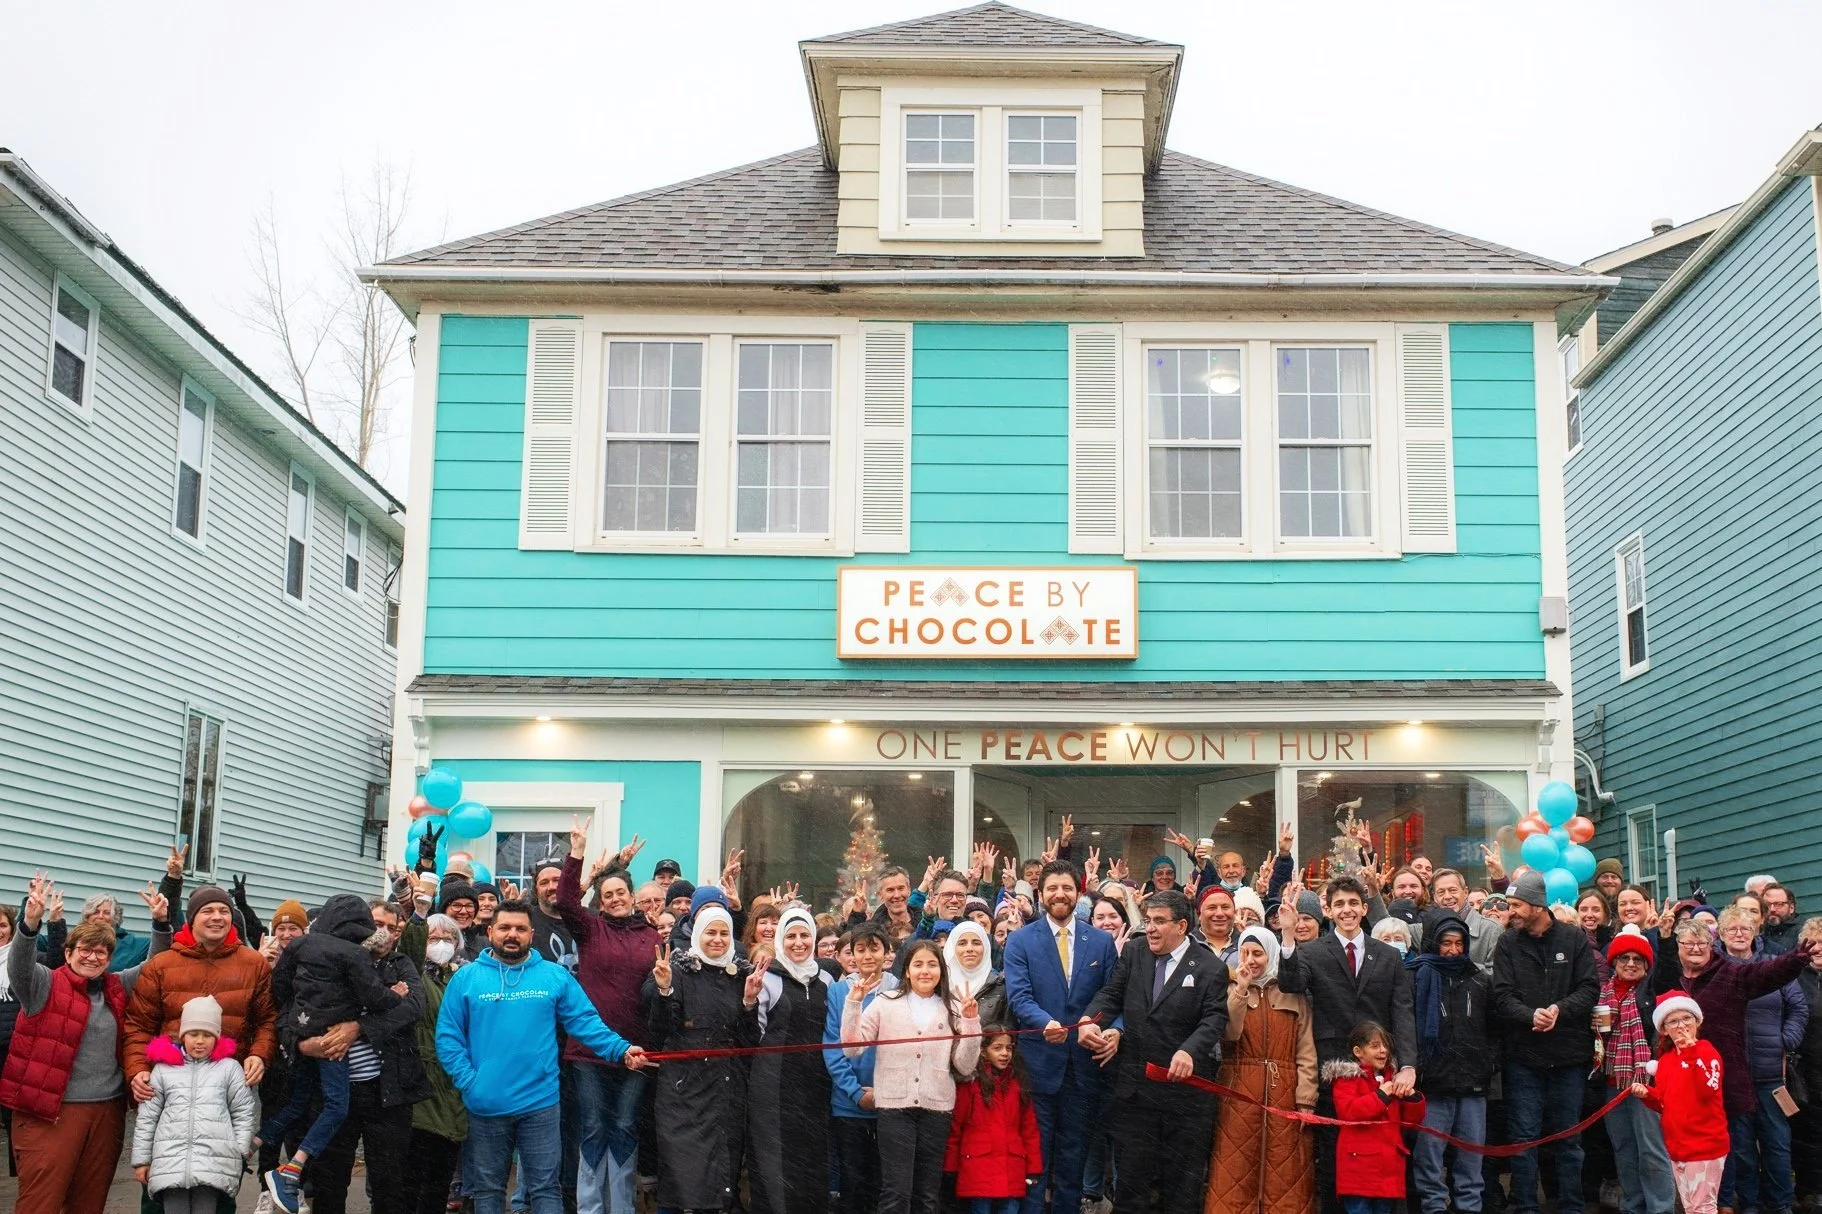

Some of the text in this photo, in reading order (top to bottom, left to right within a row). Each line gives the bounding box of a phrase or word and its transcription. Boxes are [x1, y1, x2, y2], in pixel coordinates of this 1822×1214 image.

[884, 578, 1091, 607] PEACE BY
[854, 616, 1121, 645] CHOCOLATE
[876, 729, 1374, 762] ONE PEACE WON'T HURT
